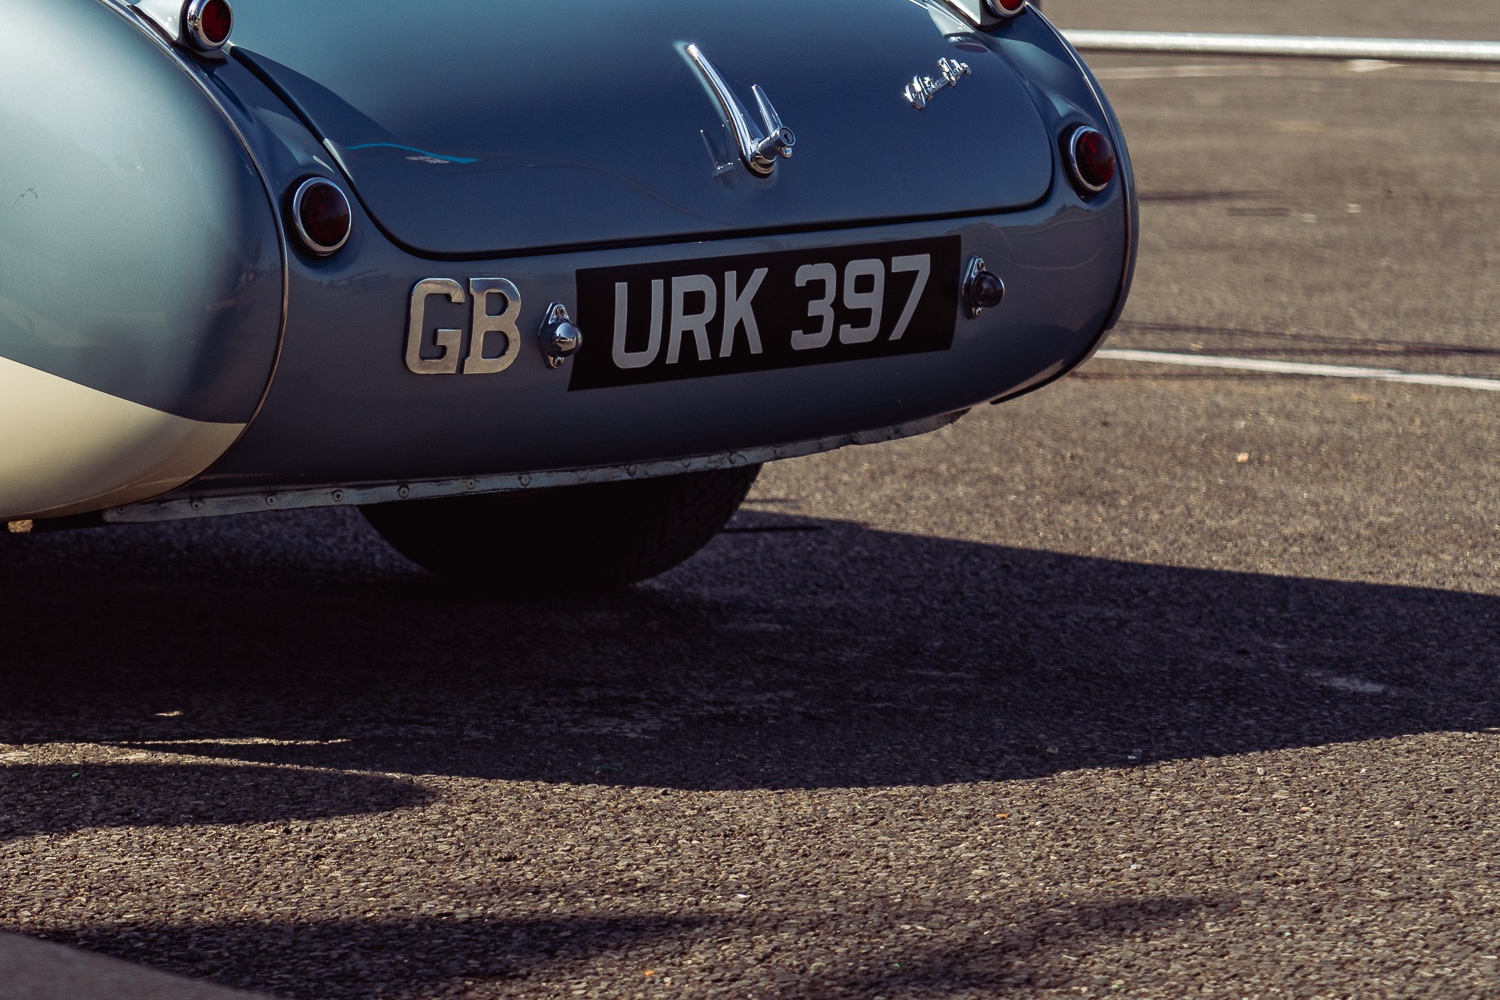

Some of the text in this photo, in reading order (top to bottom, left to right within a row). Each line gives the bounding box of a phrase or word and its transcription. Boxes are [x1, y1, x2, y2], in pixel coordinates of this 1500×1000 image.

[406, 277, 521, 375] GB
[612, 253, 931, 368] URK 397
